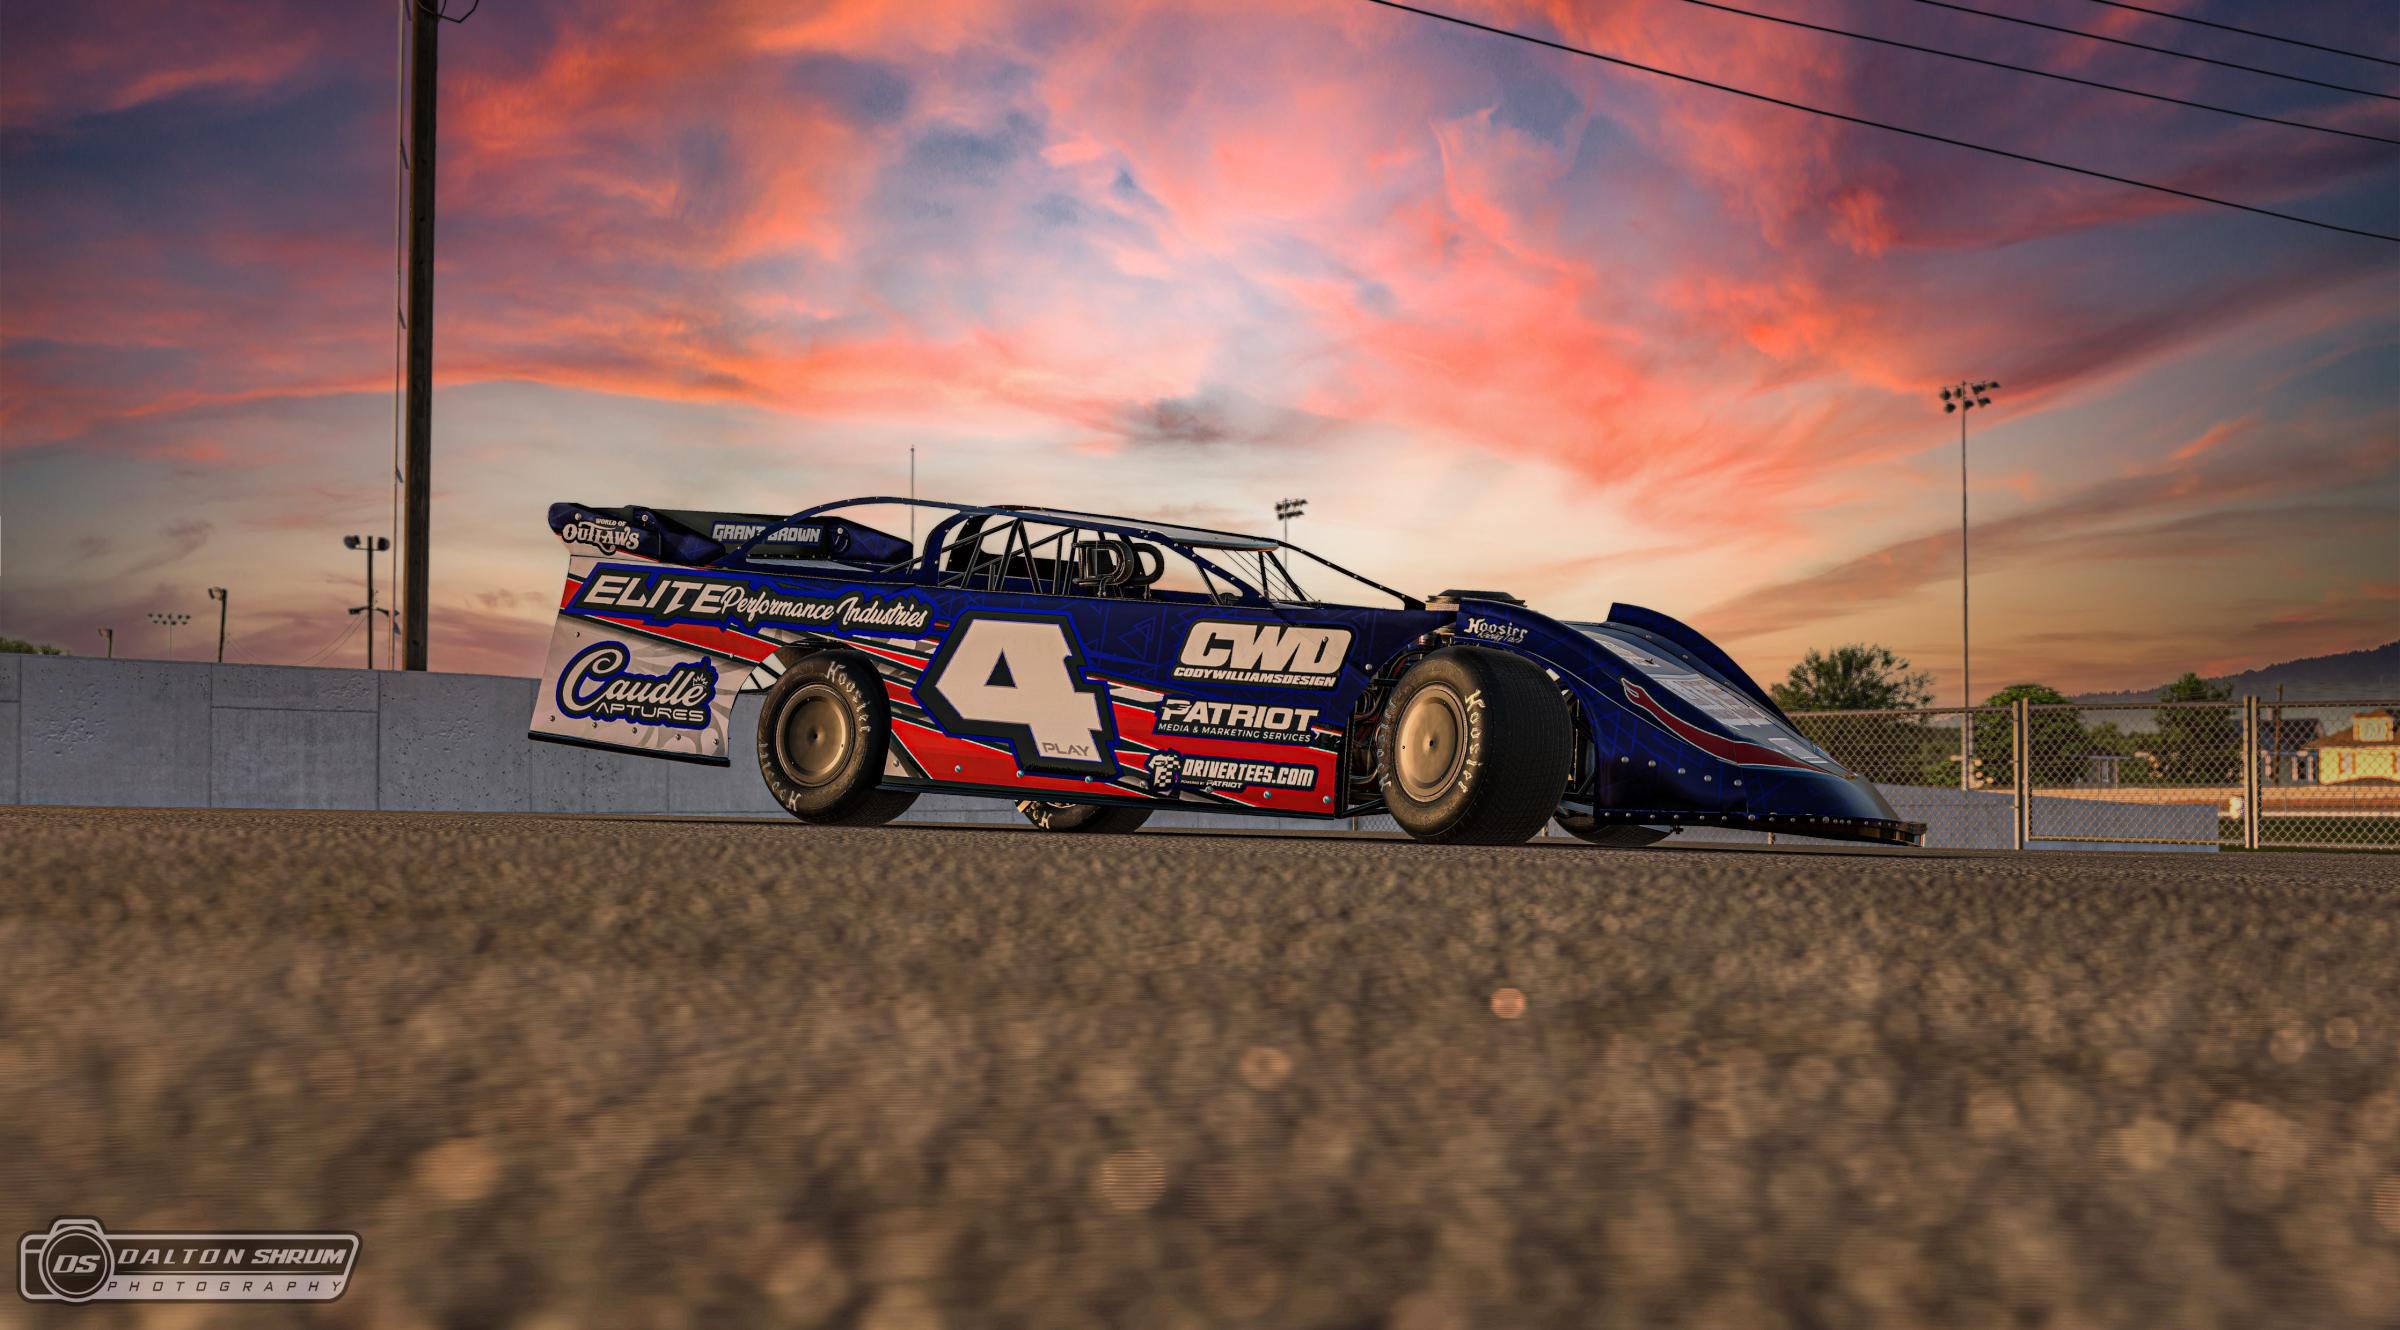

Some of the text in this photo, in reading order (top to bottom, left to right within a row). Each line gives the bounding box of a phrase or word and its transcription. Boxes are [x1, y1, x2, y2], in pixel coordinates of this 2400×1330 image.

[595, 517, 617, 525] WORLD
[583, 575, 928, 629] ELITE Performance Industries
[1180, 621, 1352, 674] CWD
[562, 648, 707, 711] Caudle
[936, 619, 1102, 762] 4
[1173, 667, 1337, 687] CODYWILLIAMSDESIGN
[1161, 698, 1319, 732] PATRIOT
[1158, 722, 1311, 742] MEDIA & MARKETING SERVICES
[1041, 742, 1089, 756] PLAY
[1181, 758, 1315, 787] DRIVERTEES.COM
[1206, 780, 1243, 789] PATRIOT
